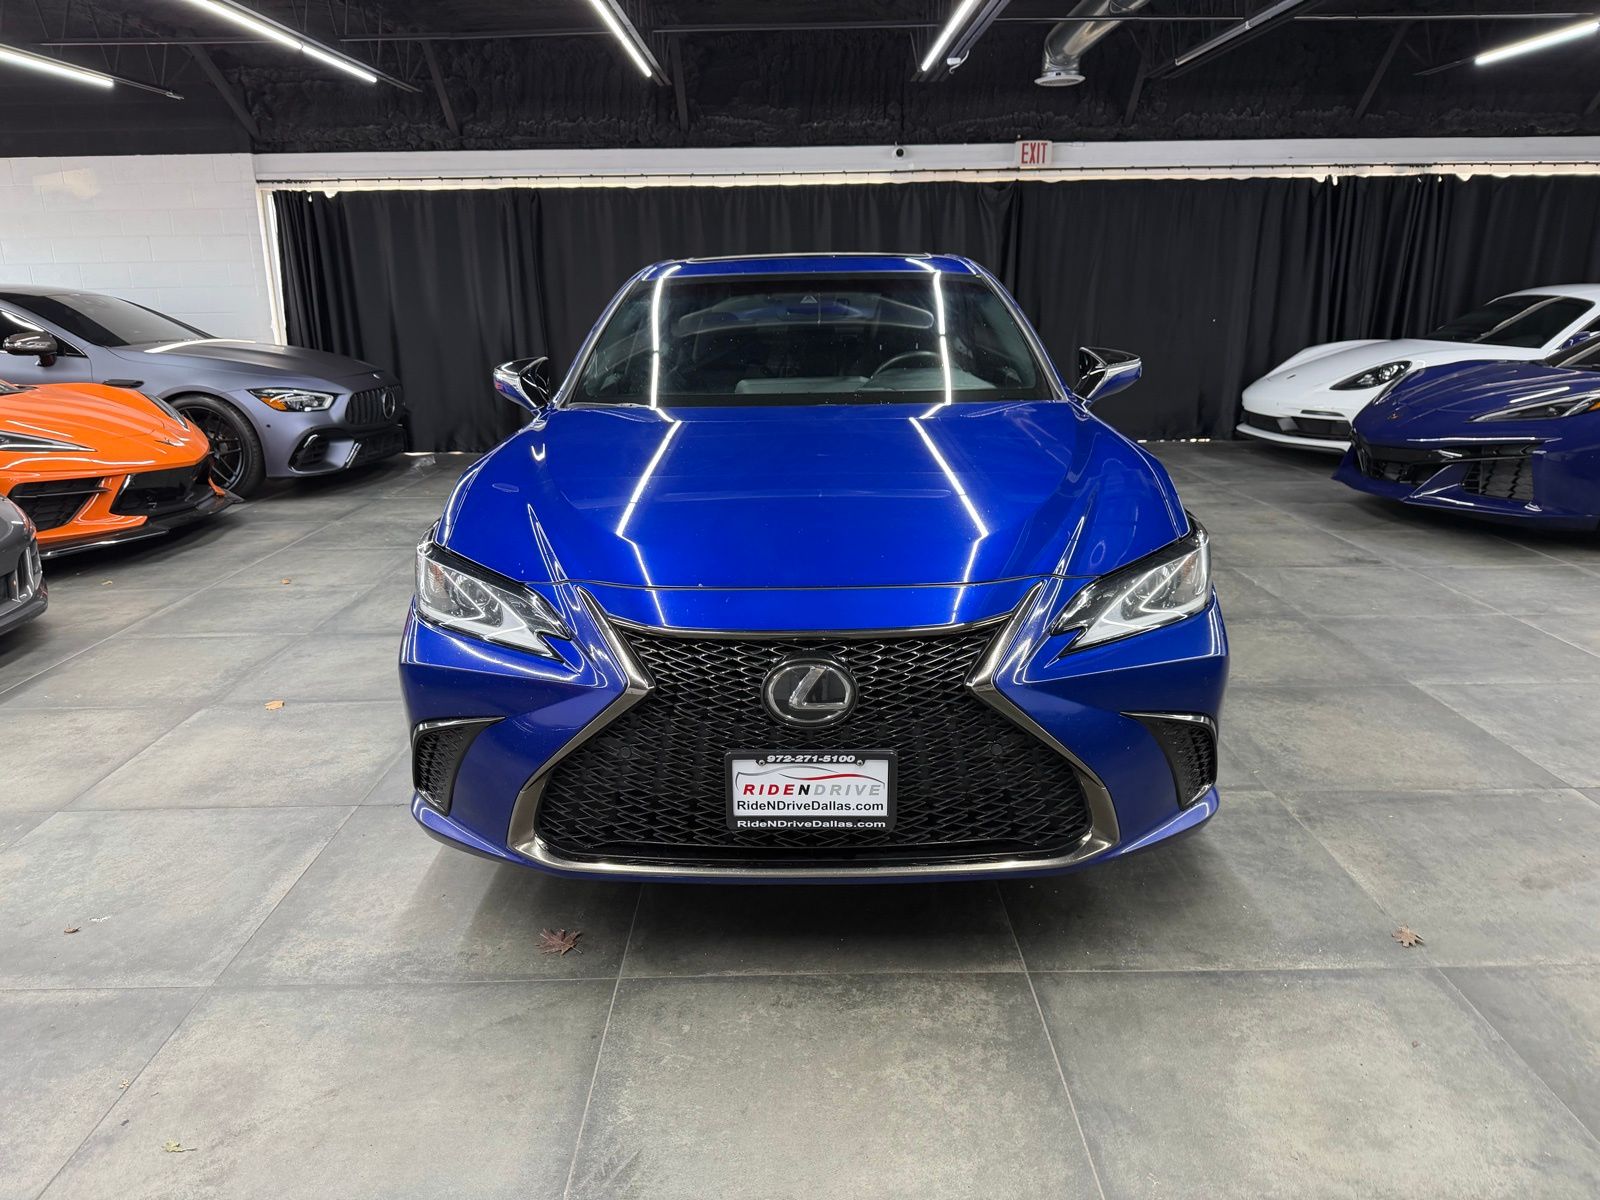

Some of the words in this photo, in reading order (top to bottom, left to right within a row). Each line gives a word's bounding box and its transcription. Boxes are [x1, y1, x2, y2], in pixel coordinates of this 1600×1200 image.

[1021, 142, 1048, 164] EXIT
[766, 755, 856, 763] 972-271-5100
[743, 784, 881, 796] RIDENDRIVE
[737, 800, 884, 811] RideNDriveDallas.com
[737, 820, 886, 828] RideNDriveDallas.com
